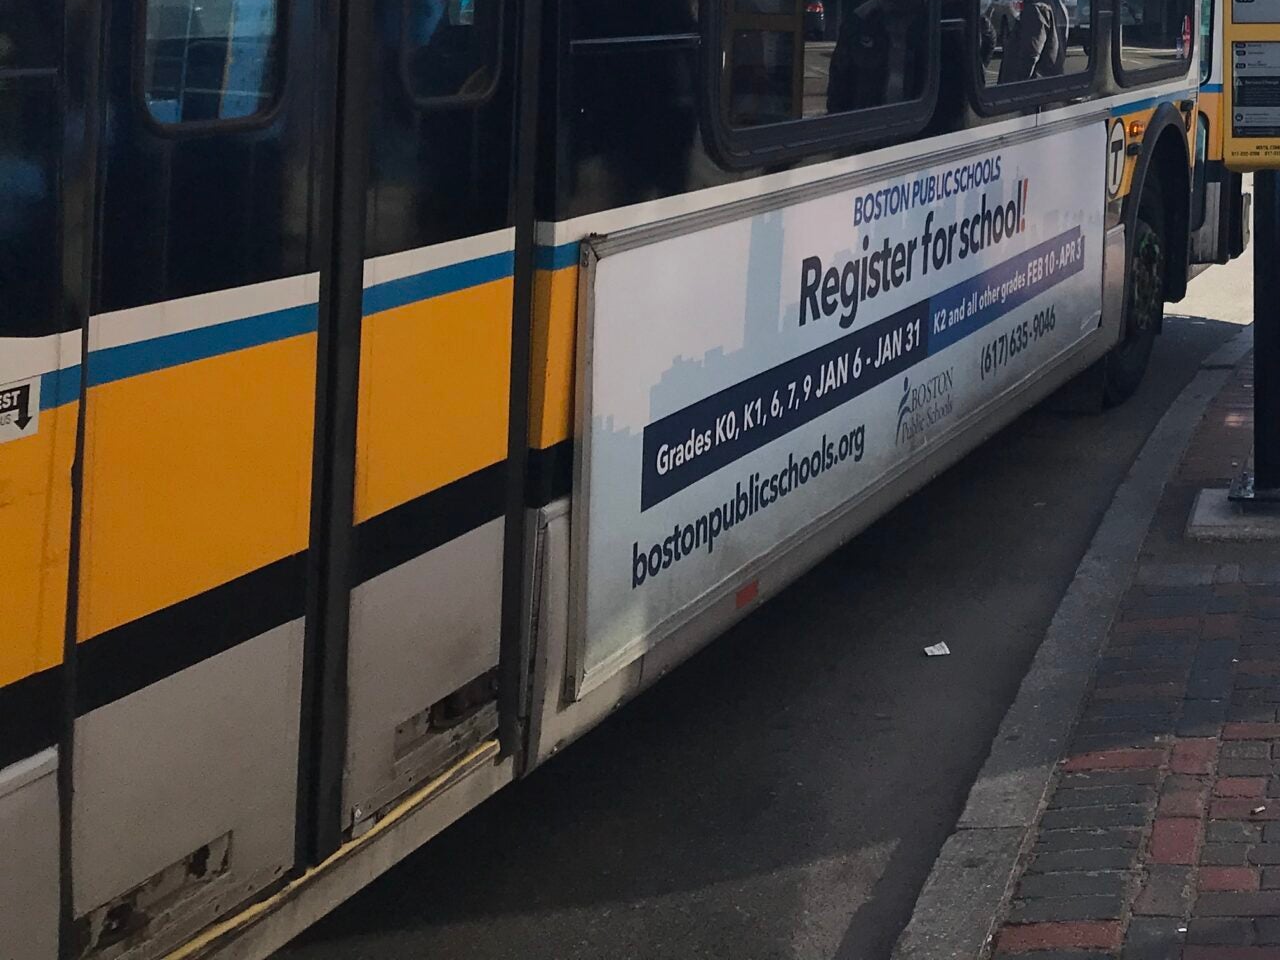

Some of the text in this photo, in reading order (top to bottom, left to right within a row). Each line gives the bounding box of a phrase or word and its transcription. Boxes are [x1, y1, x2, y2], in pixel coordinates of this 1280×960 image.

[853, 154, 1002, 227] BOSTON PUBLIC SCHOOLS
[1110, 138, 1123, 186] T
[798, 177, 1029, 330] Register for school!
[933, 309, 947, 335] K2
[948, 301, 965, 326] and
[966, 296, 977, 315] all
[978, 285, 1000, 311] other
[1001, 271, 1026, 304] grades
[1027, 257, 1043, 288] FEB
[1044, 250, 1055, 277] 10
[1059, 240, 1075, 270] APR
[656, 427, 712, 476] Grades
[743, 397, 767, 432] K1,
[770, 389, 783, 419] 6,
[787, 381, 800, 411] 7,
[803, 374, 812, 402] 9
[815, 351, 849, 398] JAN
[852, 346, 862, 379] 6
[874, 326, 902, 369] JAN
[905, 318, 921, 353] 31
[911, 366, 953, 412] BOSTON
[631, 423, 865, 591] bostonpublicschools.org
